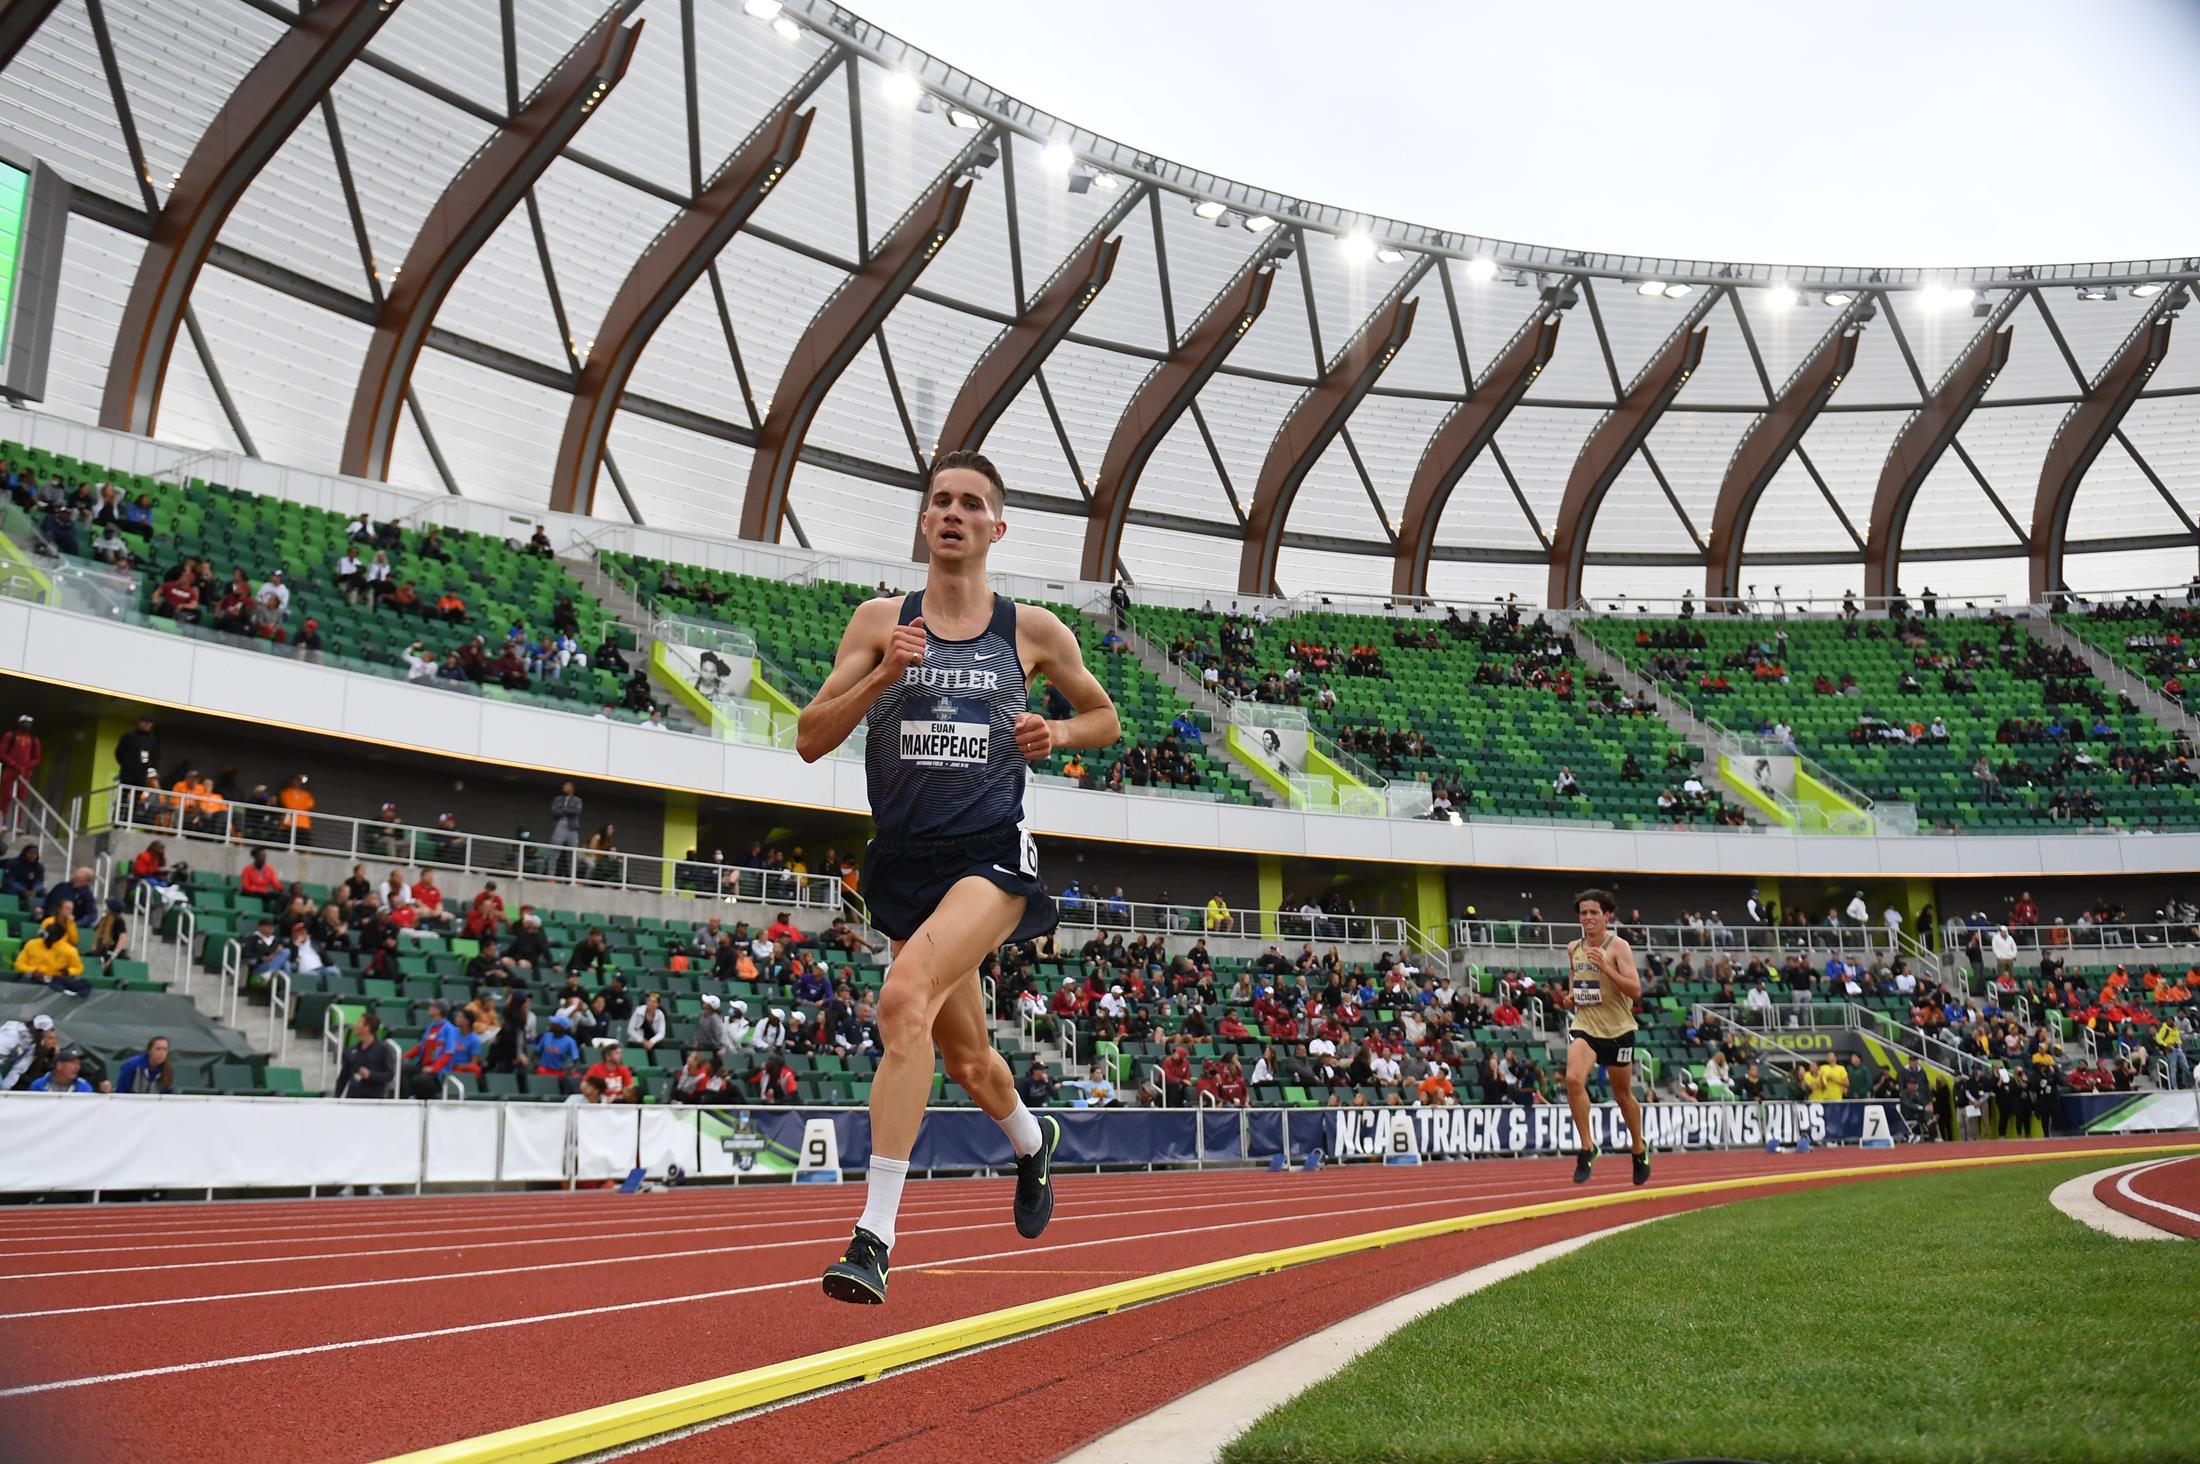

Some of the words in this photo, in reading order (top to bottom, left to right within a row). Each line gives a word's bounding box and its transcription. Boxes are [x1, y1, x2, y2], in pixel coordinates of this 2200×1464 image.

[905, 666, 998, 690] BUTLER
[931, 723, 956, 734] EUAN
[902, 734, 988, 760] MAKEPEACE
[1335, 1109, 1408, 1156] NCA
[1416, 1108, 1501, 1153] TRACK
[1509, 1107, 1528, 1151] &
[1610, 1103, 1826, 1148] CAMPIONSHIPS
[1869, 1118, 1880, 1137] 7
[809, 1139, 827, 1167] 9
[1394, 1132, 1409, 1153] 8
